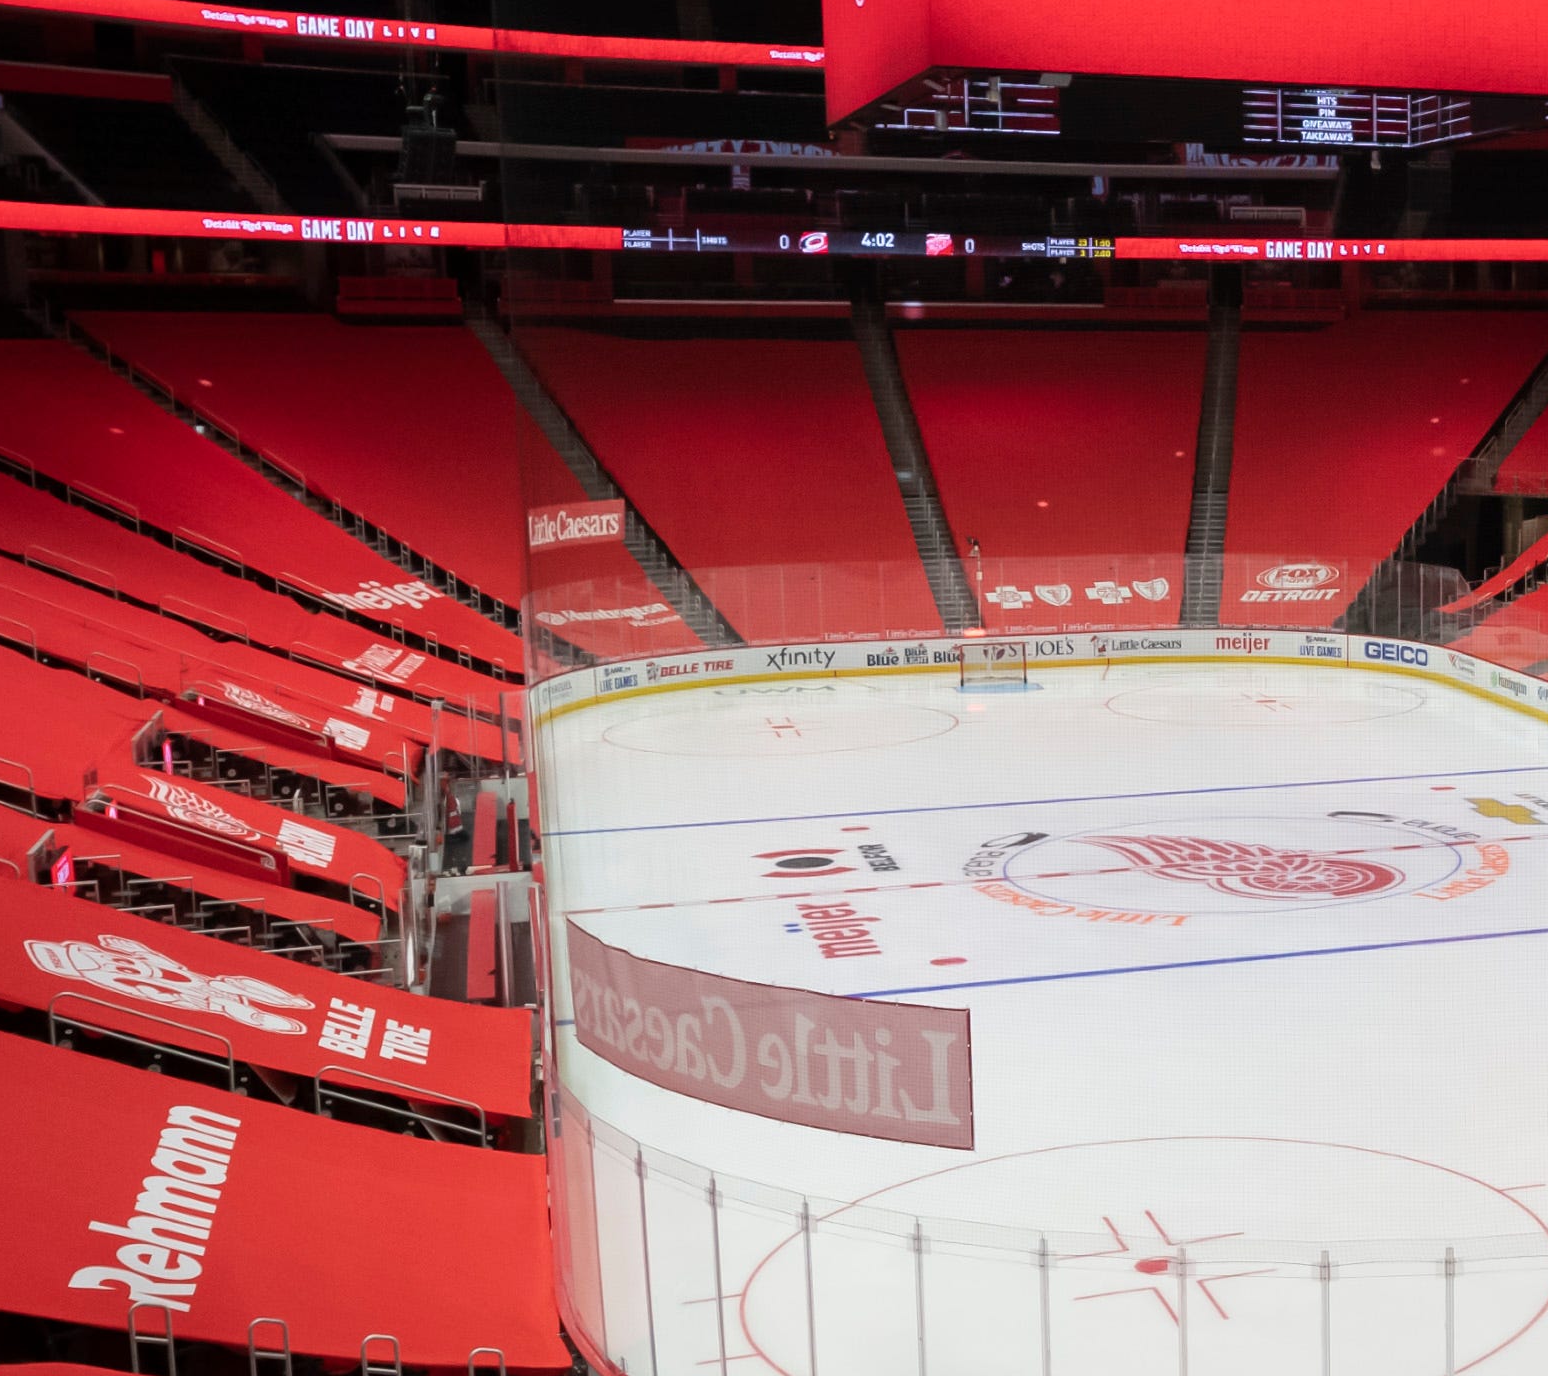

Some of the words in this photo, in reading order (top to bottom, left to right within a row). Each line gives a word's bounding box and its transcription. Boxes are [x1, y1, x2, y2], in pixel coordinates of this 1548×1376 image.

[296, 15, 340, 36] GAME
[344, 20, 374, 39] DAY
[383, 26, 436, 40] LIVE
[301, 219, 342, 240] GAME
[346, 221, 374, 241] DAY
[383, 226, 440, 237] LIVE
[861, 233, 895, 248] 4:02
[779, 234, 790, 250] 0
[964, 238, 975, 254] 0
[1265, 241, 1302, 258] GAME
[1307, 241, 1333, 259] DAY
[1339, 243, 1386, 255] LIVE
[557, 510, 620, 541] Caesars
[321, 580, 445, 610] meijer
[1240, 589, 1341, 603] DETROIT
[1035, 636, 1074, 657] JOE'S
[1112, 639, 1139, 651] Little
[1141, 638, 1182, 650] Caesars
[1215, 632, 1270, 654] meijer
[1364, 641, 1428, 667] GEICO
[660, 663, 699, 678] BELLE
[703, 660, 734, 672] TIRE
[766, 647, 836, 672] xfinity
[867, 654, 899, 667] Blue
[783, 902, 883, 959] meijer
[318, 997, 376, 1060] BELLE
[379, 1019, 432, 1065] TIRE
[68, 1105, 242, 1313] Rehmann
